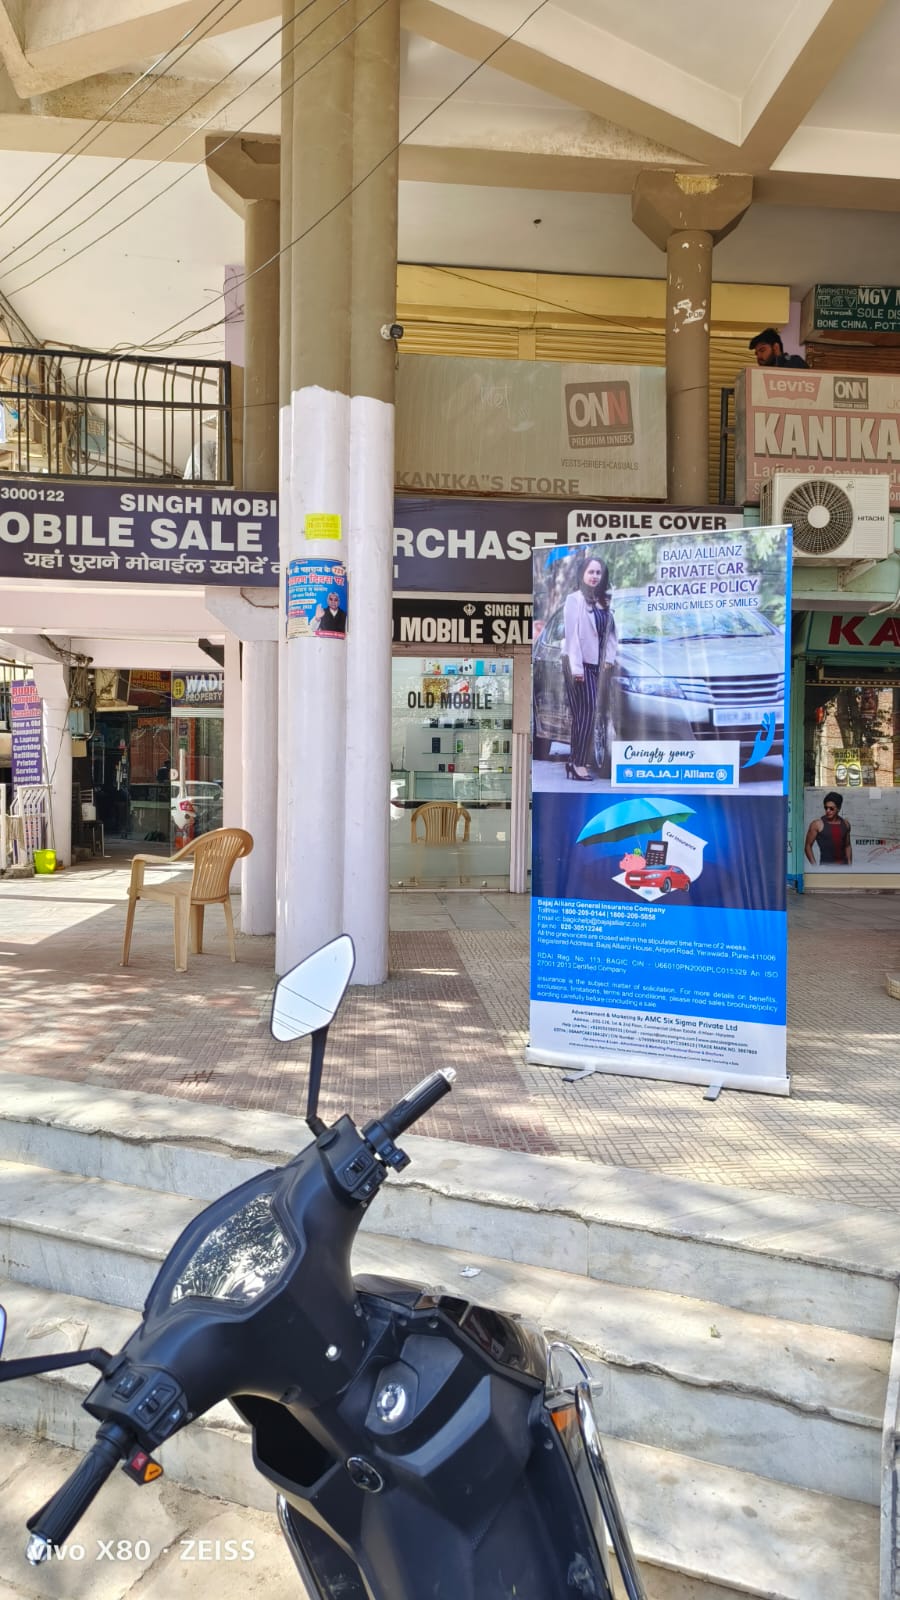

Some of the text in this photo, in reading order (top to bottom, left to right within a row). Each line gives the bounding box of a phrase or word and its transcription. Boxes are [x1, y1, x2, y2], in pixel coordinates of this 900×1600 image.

[857, 288, 891, 305] MGV
[857, 308, 884, 319] SOLE
[817, 320, 839, 328] BONE
[835, 381, 867, 399] ONN
[569, 391, 628, 427] ONN
[572, 434, 633, 446] PREMIUM INNERS
[754, 411, 900, 462] KANIKA
[510, 476, 579, 494] STORE
[1, 487, 65, 502] 3000122
[120, 493, 277, 517] SINGH MOBI
[576, 513, 727, 531] MOBILE COVER
[0, 511, 134, 548] OBILE
[150, 518, 262, 552] SALE
[663, 545, 742, 561] BAJAJ ALLIANZ
[23, 549, 64, 569] यहां
[69, 551, 120, 574] पुराने
[125, 552, 205, 573] मोबाईल
[210, 555, 268, 575] खरीदें
[661, 562, 744, 578] PRIVATE CAR
[648, 579, 758, 597] PACKAGE POLICY
[484, 604, 520, 617] SINGH
[648, 598, 758, 611] ENSURING MILES OF SMILES
[401, 617, 483, 643] MOBILE
[186, 692, 222, 702] PROPERTY
[408, 691, 492, 710] OLD MOBILE
[624, 745, 695, 763] Caringly yours
[636, 769, 714, 778] BAJAJ Allianz
[601, 903, 634, 911] Insurance
[634, 905, 666, 914] Company
[598, 965, 627, 973] Company
[680, 987, 691, 995] For
[644, 1015, 661, 1024] AMC
[663, 1017, 673, 1025] Six
[675, 1018, 697, 1027] Sigma
[699, 1020, 724, 1030] Private
[725, 1023, 738, 1032] Ltd
